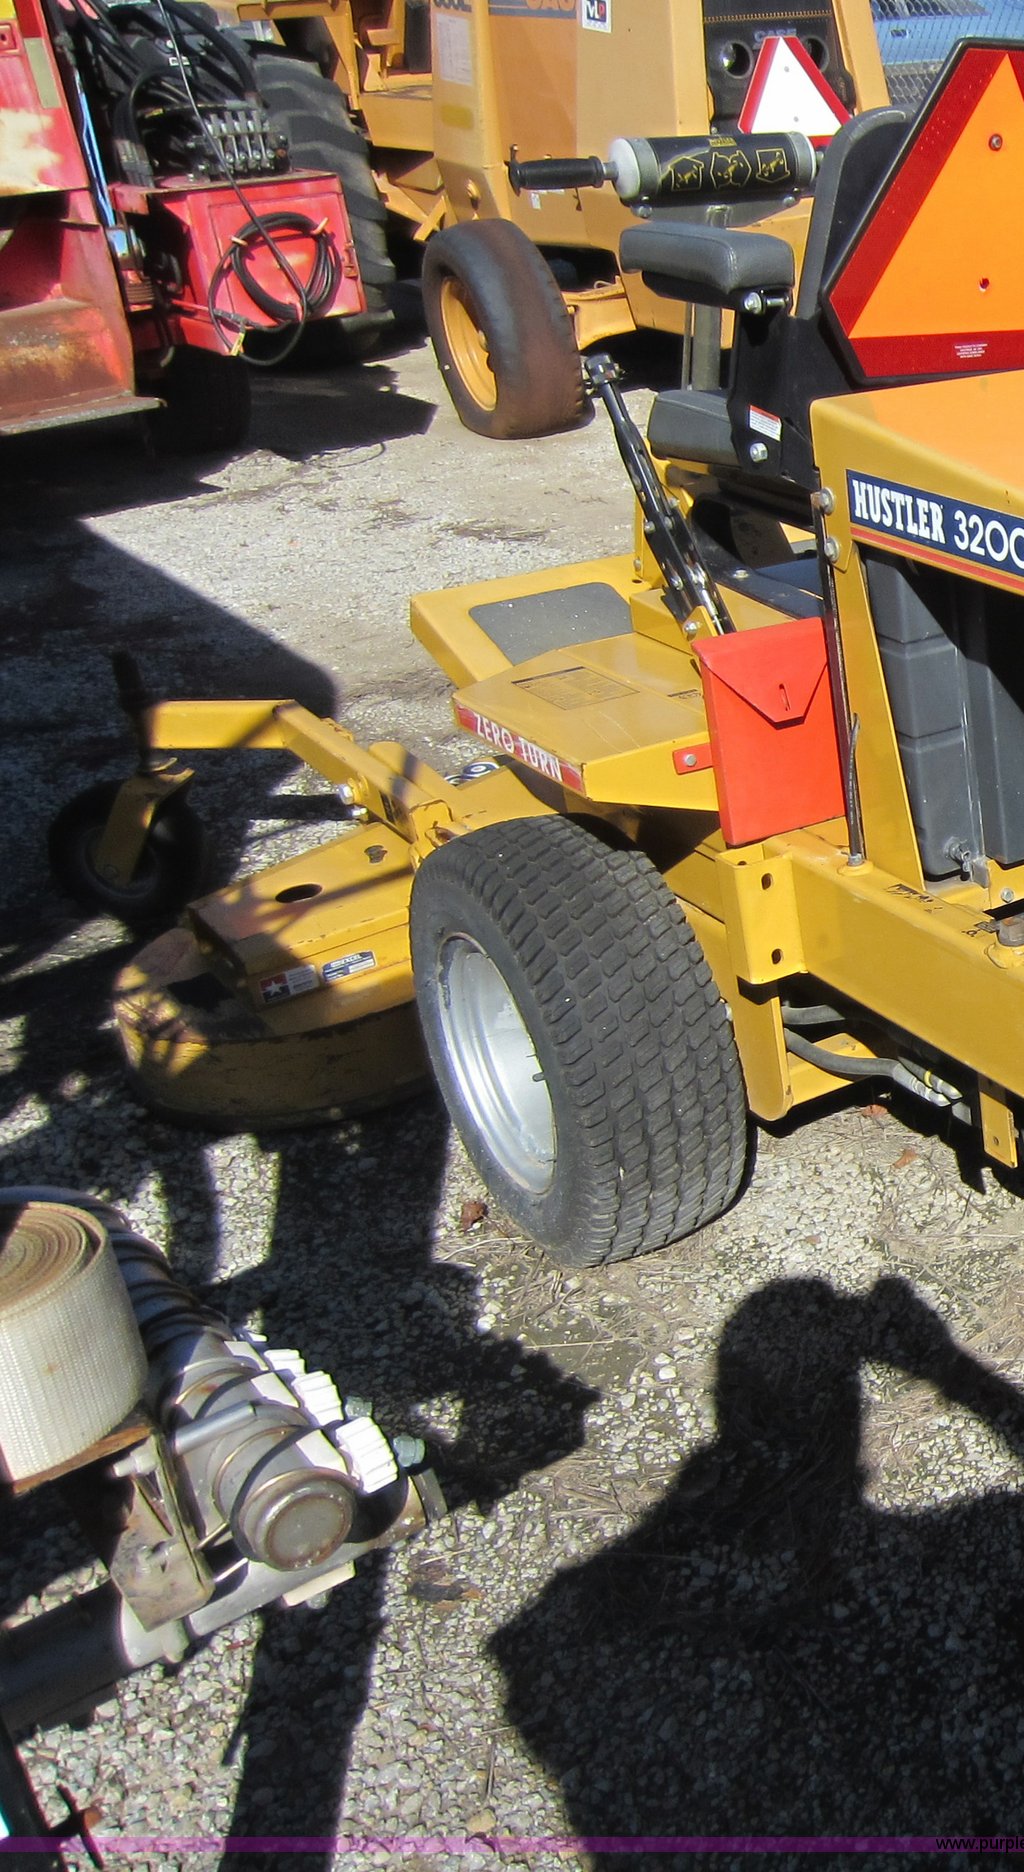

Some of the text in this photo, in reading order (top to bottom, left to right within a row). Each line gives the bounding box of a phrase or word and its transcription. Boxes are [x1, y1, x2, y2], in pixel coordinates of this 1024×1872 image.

[852, 479, 946, 544] HUSTLER
[474, 712, 563, 782] ZERO TURN
